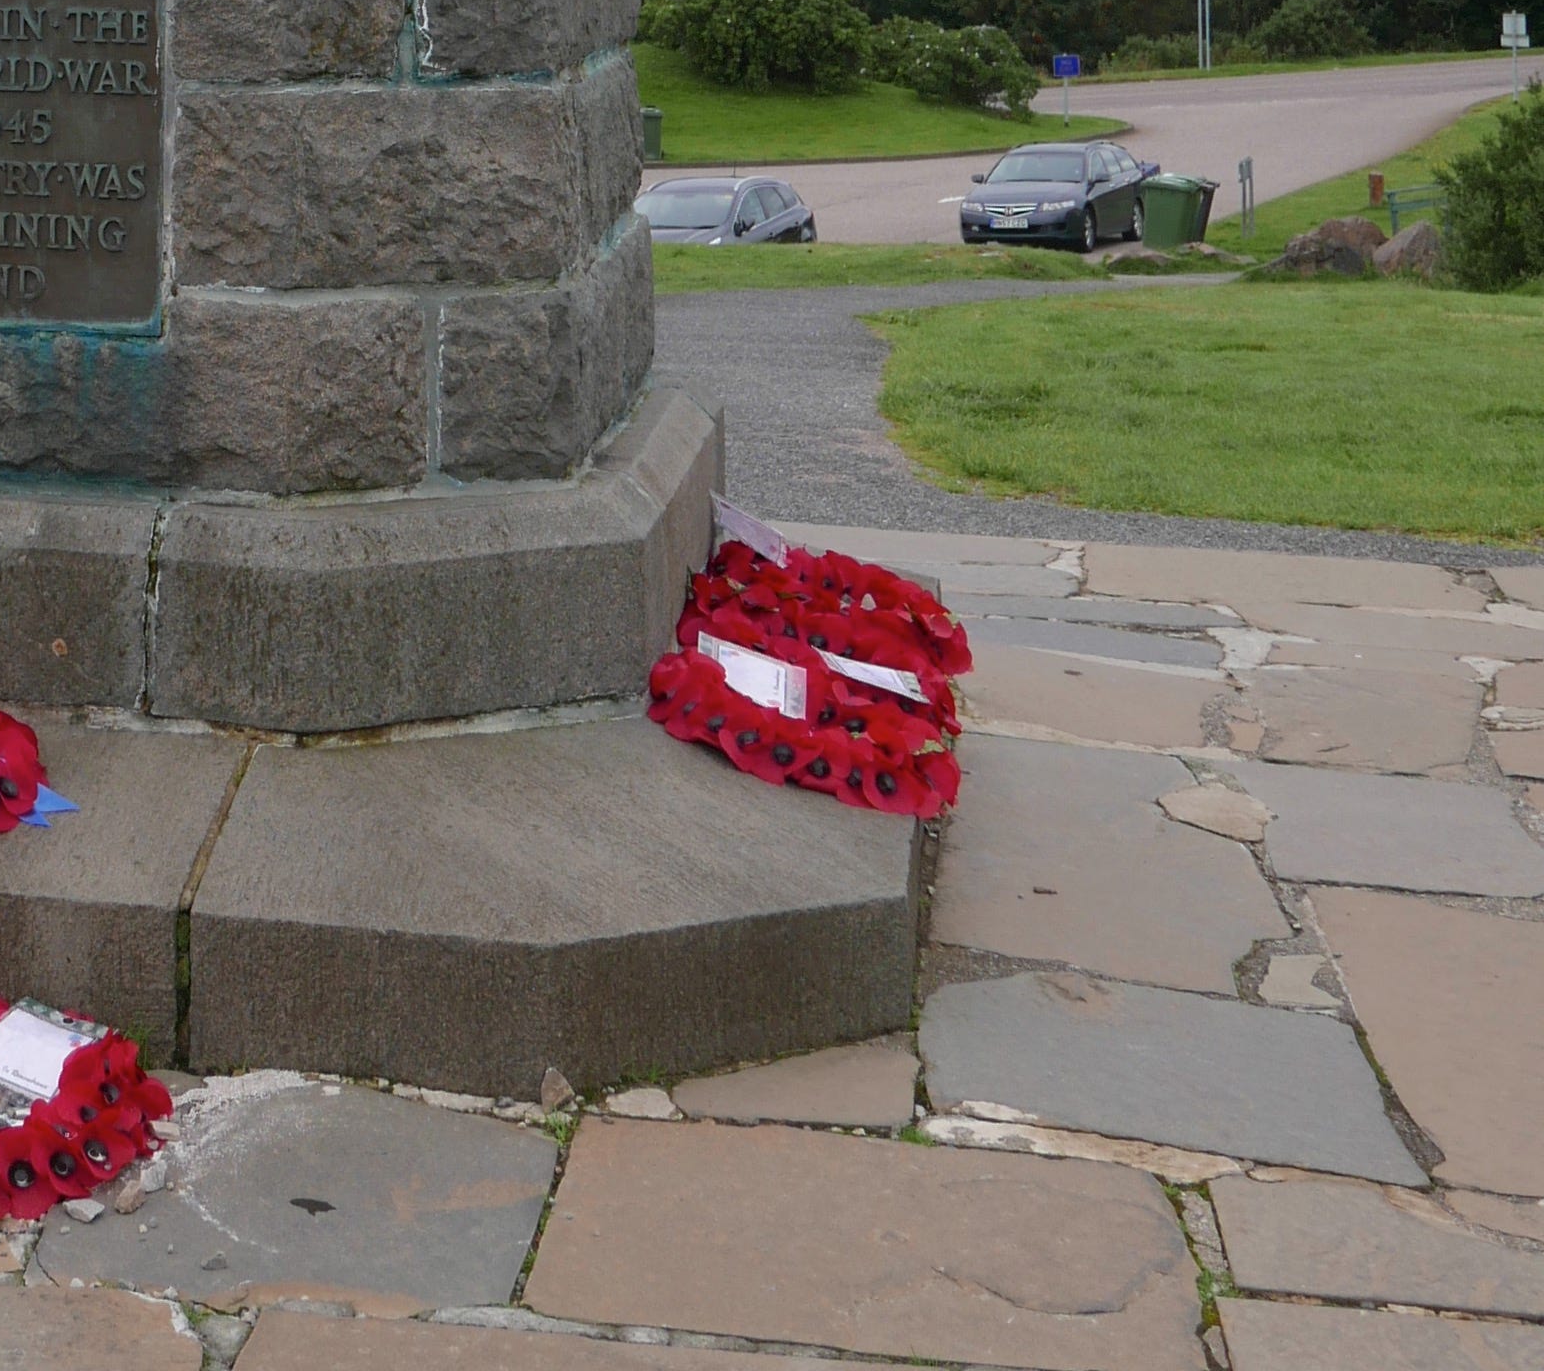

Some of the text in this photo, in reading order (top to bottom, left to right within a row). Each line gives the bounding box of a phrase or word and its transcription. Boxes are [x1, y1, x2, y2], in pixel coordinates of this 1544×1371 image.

[0, 5, 47, 41] IN
[65, 7, 149, 45] THE
[62, 58, 156, 95] WAR
[64, 161, 147, 201] WAS
